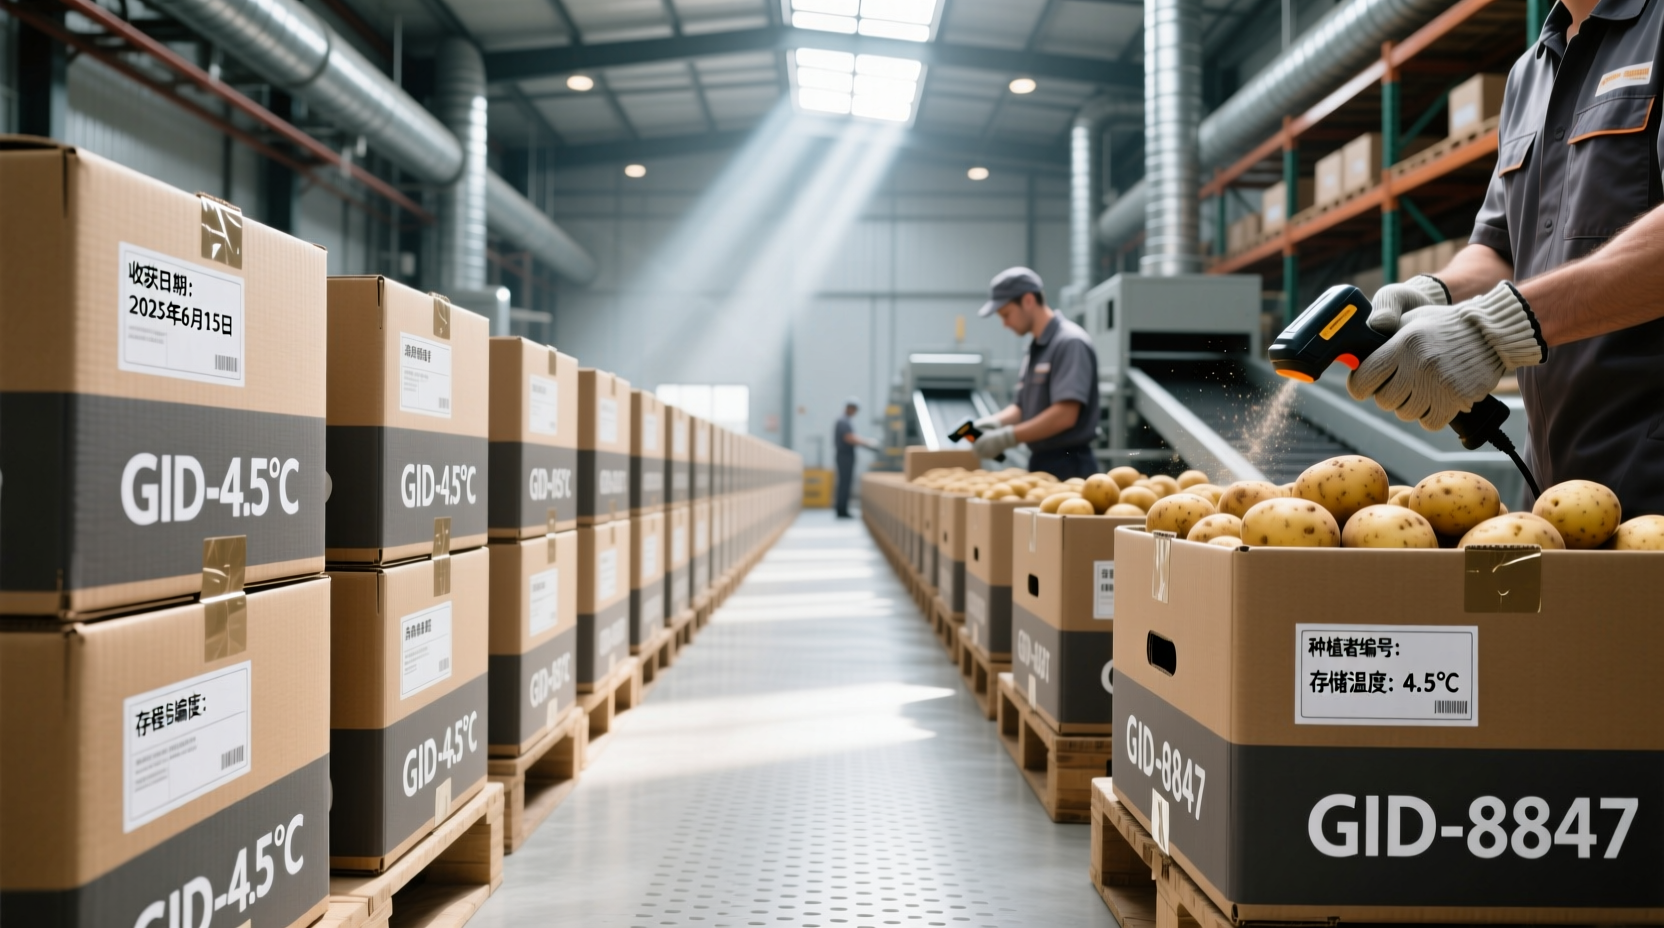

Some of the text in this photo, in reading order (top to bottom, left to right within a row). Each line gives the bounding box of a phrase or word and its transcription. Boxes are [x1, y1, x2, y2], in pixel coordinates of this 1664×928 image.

[129, 295, 232, 337] 2025年6月15日
[120, 452, 299, 526] GID-4.5°C
[401, 464, 476, 508] GID-4.5°C
[1308, 636, 1400, 658] 种植者编号:
[402, 710, 477, 797] GID-4.5°C
[1126, 714, 1206, 820] GID-8847
[1308, 793, 1639, 859] GID-8847
